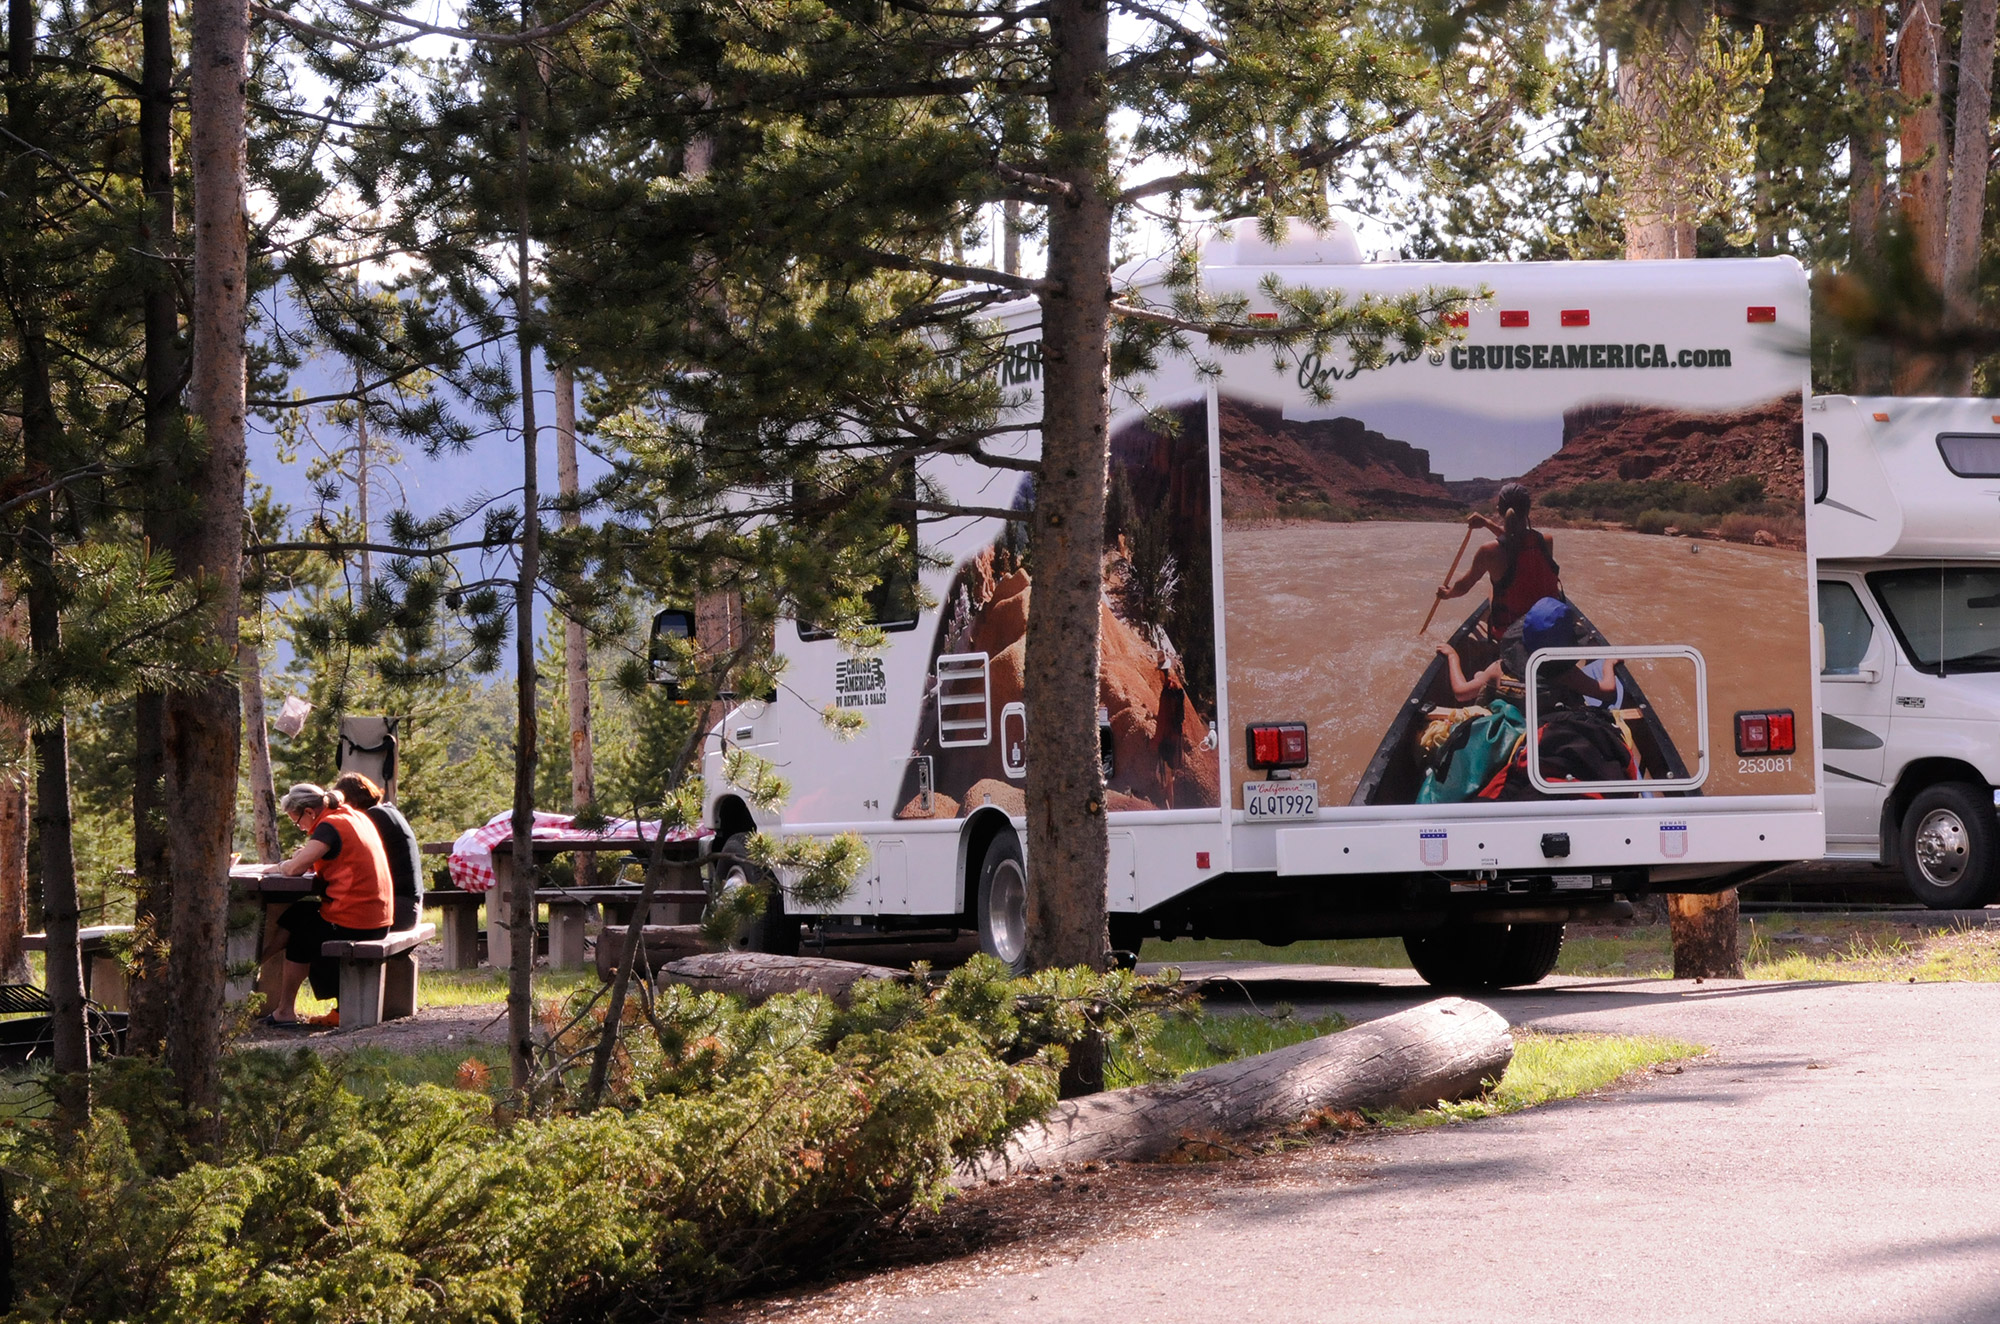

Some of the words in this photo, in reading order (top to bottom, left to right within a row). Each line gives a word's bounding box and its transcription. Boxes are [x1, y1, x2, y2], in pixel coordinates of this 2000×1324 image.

[1450, 343, 1732, 370] CRUISEAMERICA.com
[847, 658, 871, 675] CRUISE
[845, 675, 875, 692] AMERICA
[844, 695, 863, 707] RENTAL
[870, 693, 886, 704] SALES
[1737, 757, 1792, 774] 253081
[1258, 784, 1302, 795] California
[1249, 795, 1314, 815] 6LQT992
